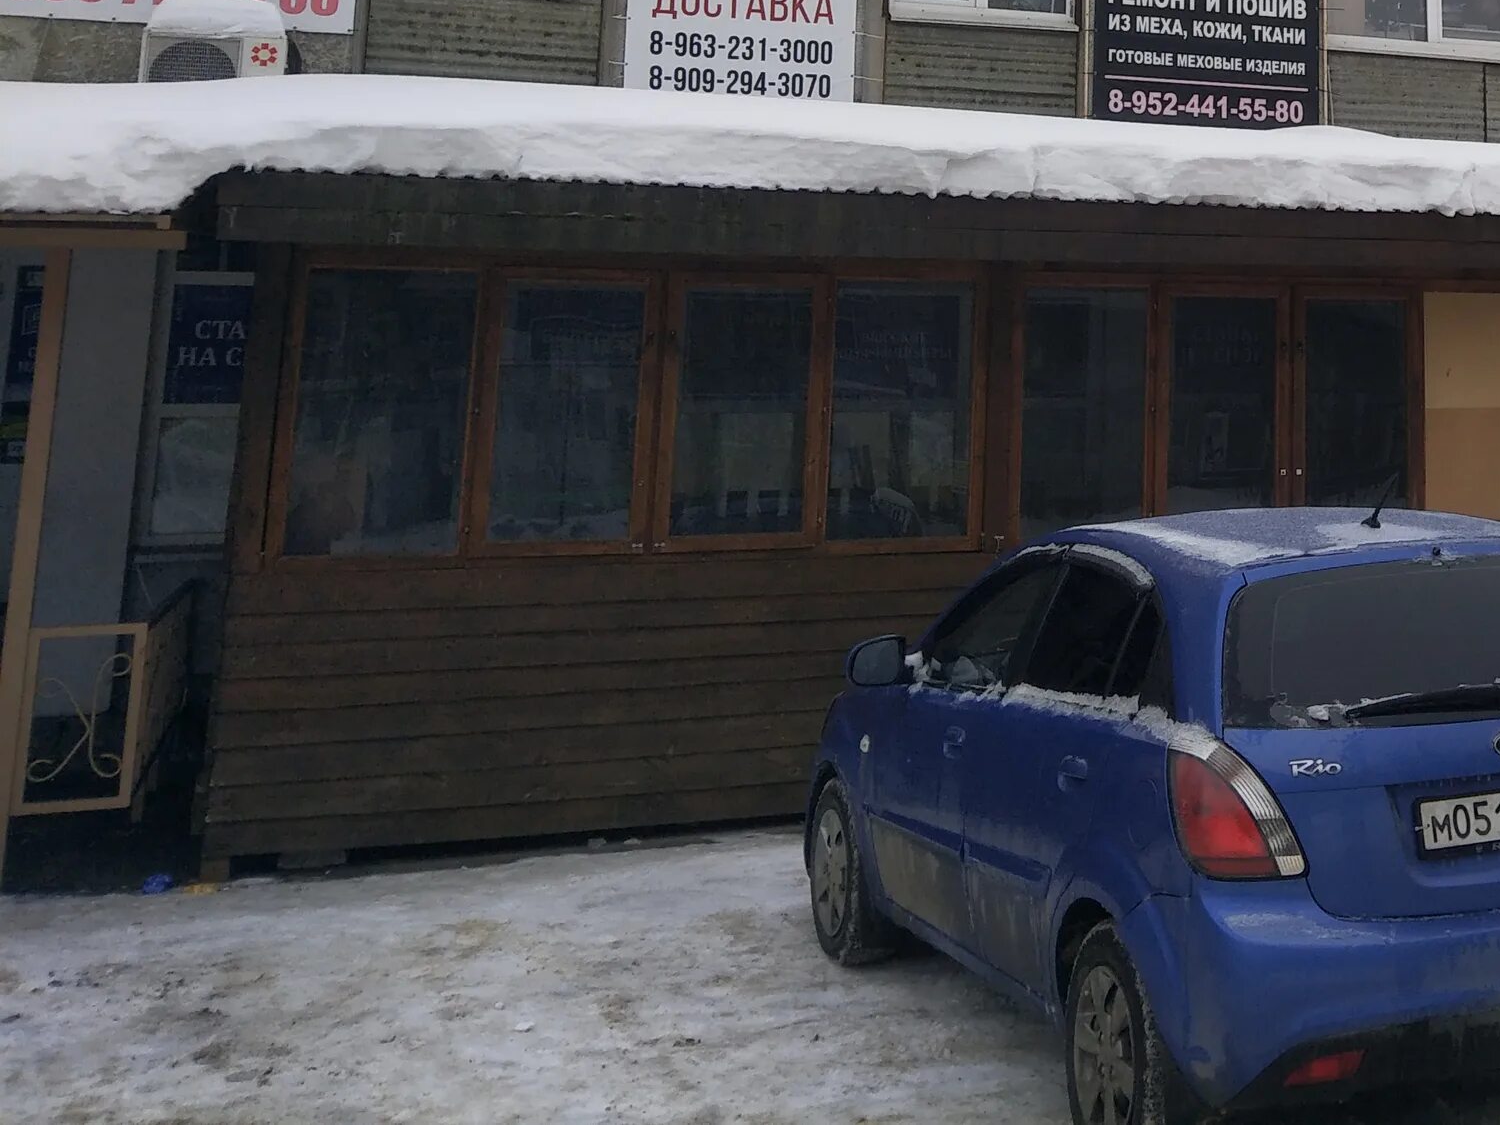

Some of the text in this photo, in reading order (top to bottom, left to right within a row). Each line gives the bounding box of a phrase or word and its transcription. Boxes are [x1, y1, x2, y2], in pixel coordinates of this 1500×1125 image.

[1108, 13, 1306, 45] ИЗ МЕХА, КОЖИ, ТКАНИ
[649, 30, 833, 65] 8-963-231-3000
[1107, 48, 1306, 76] ГОТОВЫЕ МЕХОВЫЕ ИЗДЕЛИЯ
[649, 65, 831, 98] 8-909-294-3070
[1108, 88, 1304, 123] 8-952-441-55-80
[176, 347, 216, 367] НА
[1289, 757, 1342, 777] Rio
